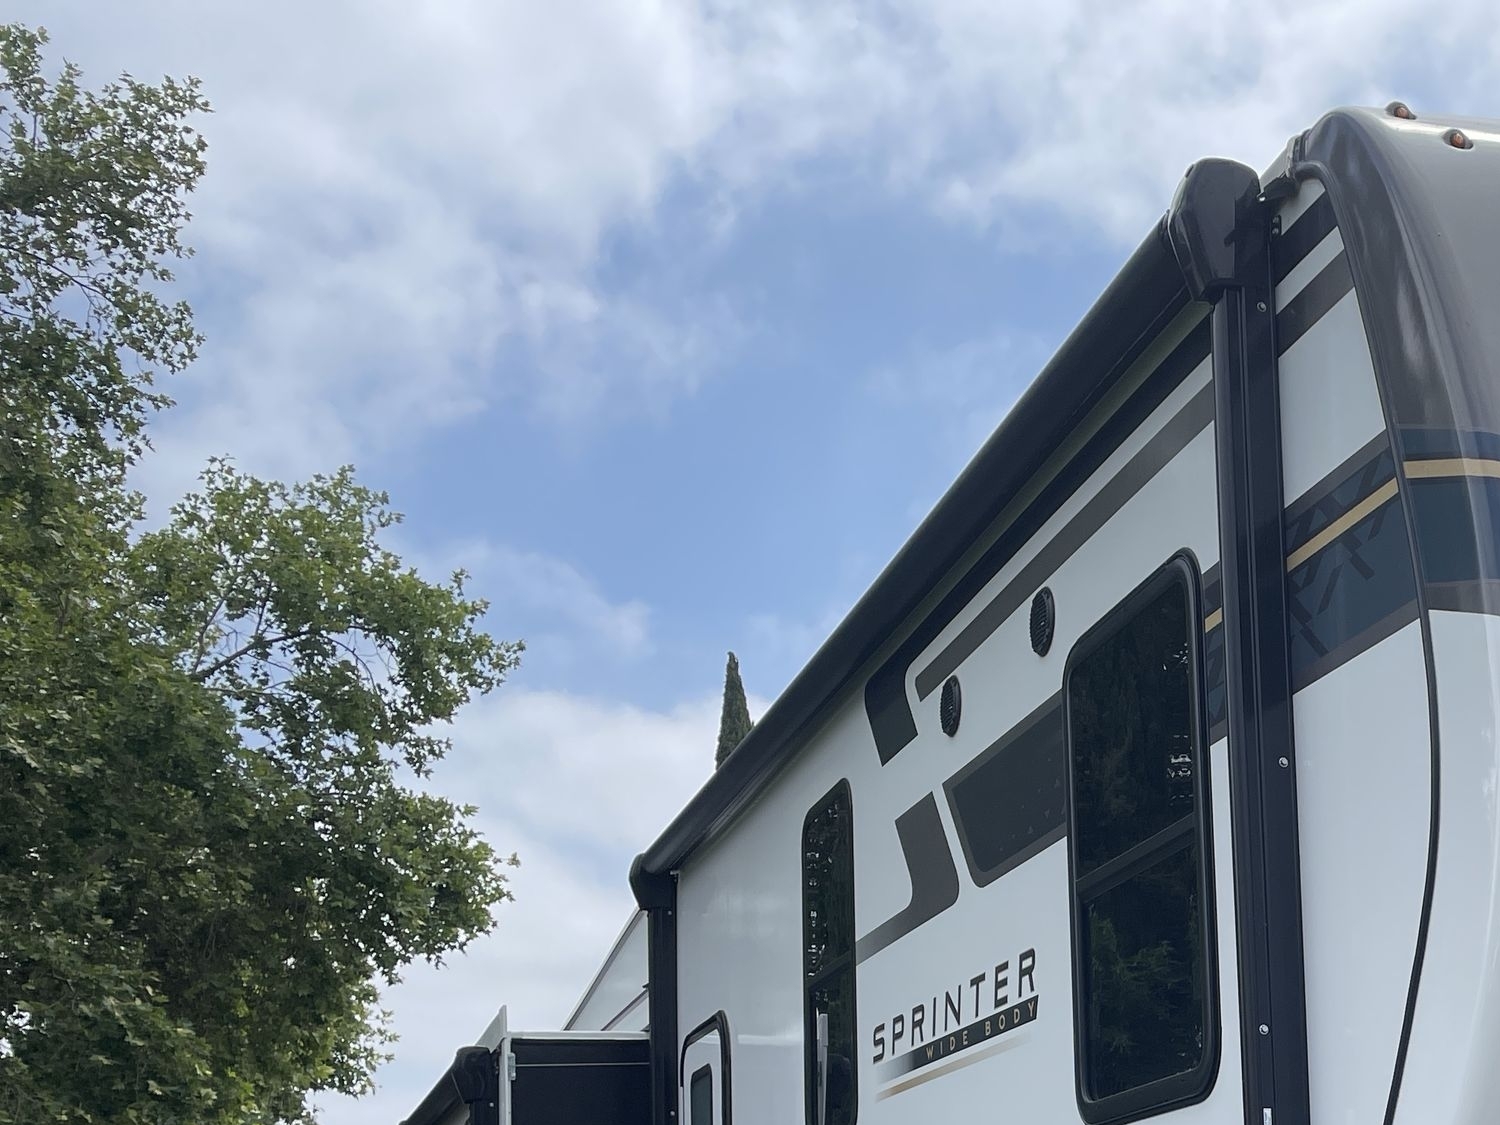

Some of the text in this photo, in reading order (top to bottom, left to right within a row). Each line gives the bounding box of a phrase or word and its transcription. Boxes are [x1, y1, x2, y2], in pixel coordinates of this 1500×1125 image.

[872, 947, 1037, 1065] SPRINTER
[926, 1002, 1036, 1060] WIDE BODY
